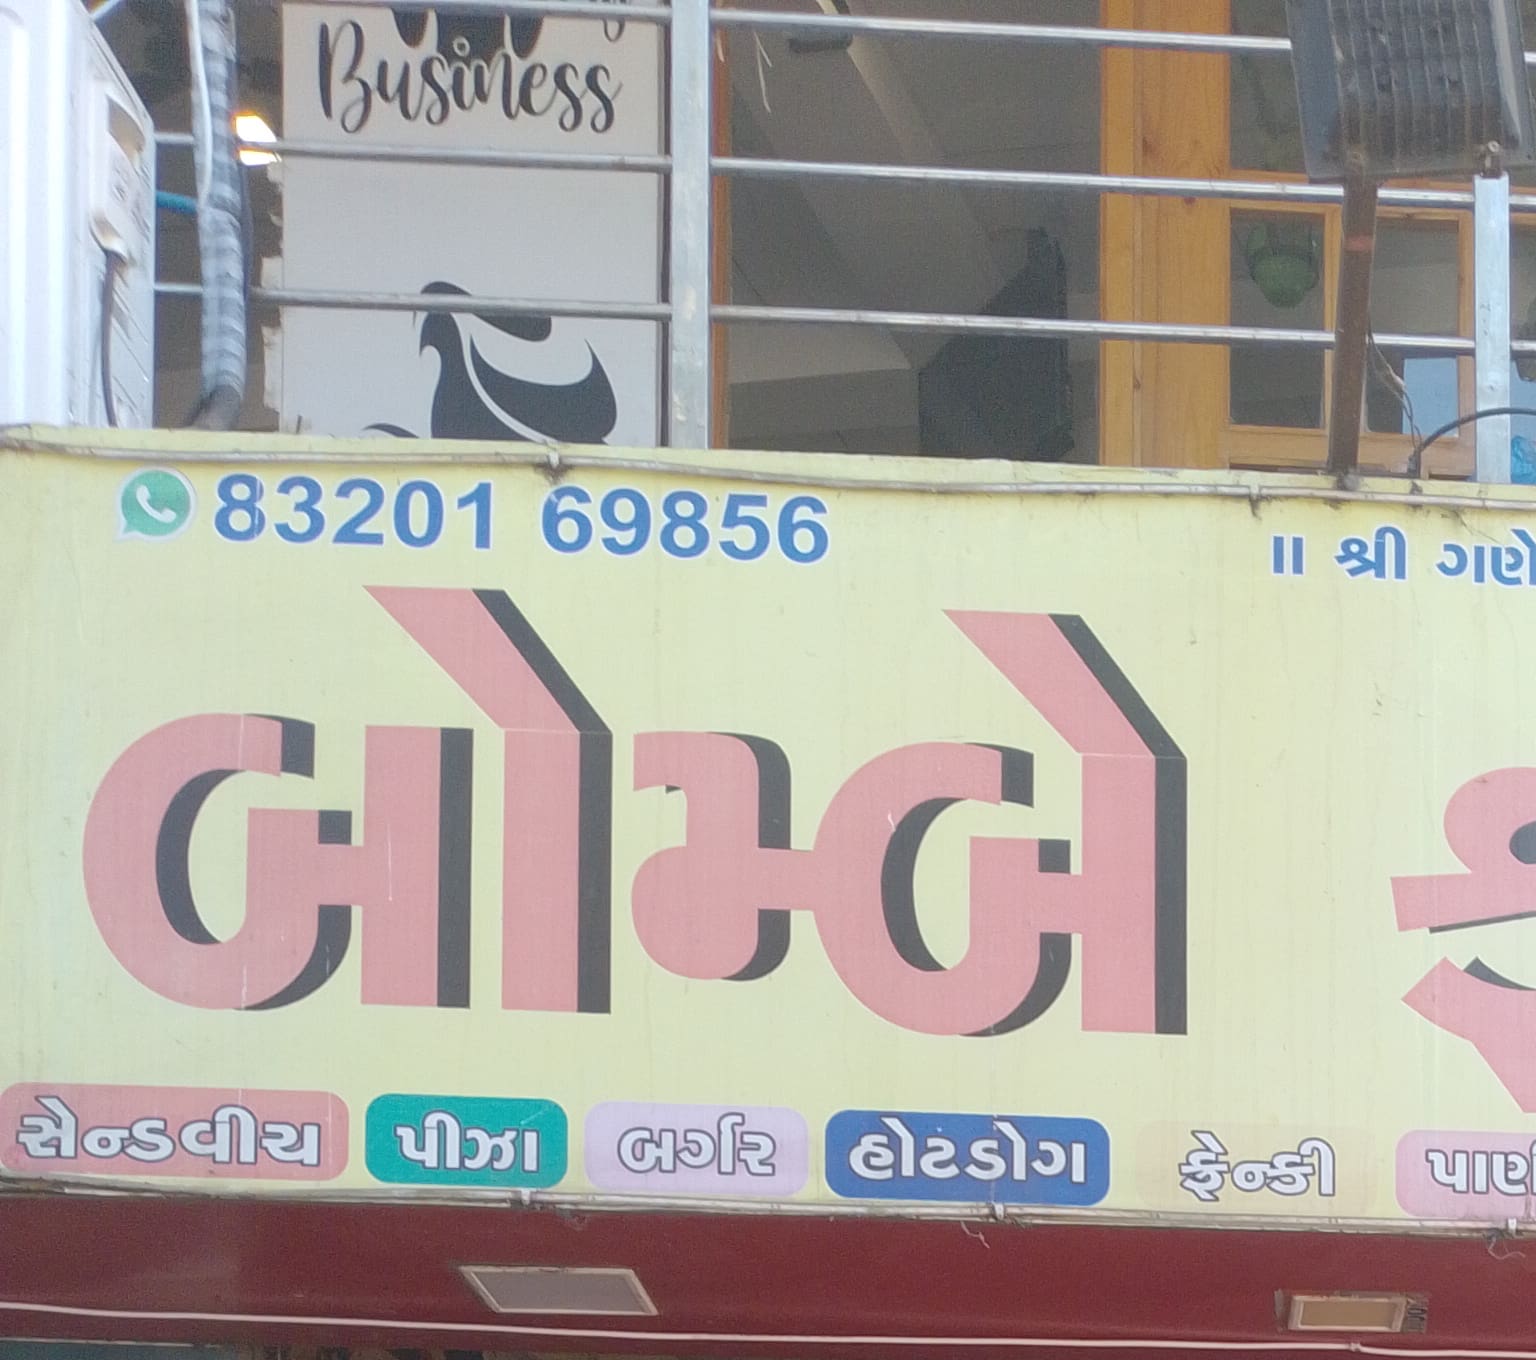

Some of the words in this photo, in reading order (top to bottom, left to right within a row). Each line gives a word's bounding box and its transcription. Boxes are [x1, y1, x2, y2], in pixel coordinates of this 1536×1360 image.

[319, 20, 622, 134] Business
[214, 473, 494, 550] 83201
[541, 487, 831, 563] 69856
[1333, 525, 1408, 580] શ્રી
[81, 585, 1188, 1038] બોમ્બે
[16, 1095, 320, 1167] સેન્ડવીચ
[395, 1110, 540, 1174] પીઝા
[618, 1113, 775, 1177] બર્ગર
[848, 1114, 1087, 1185] હોટડોગ
